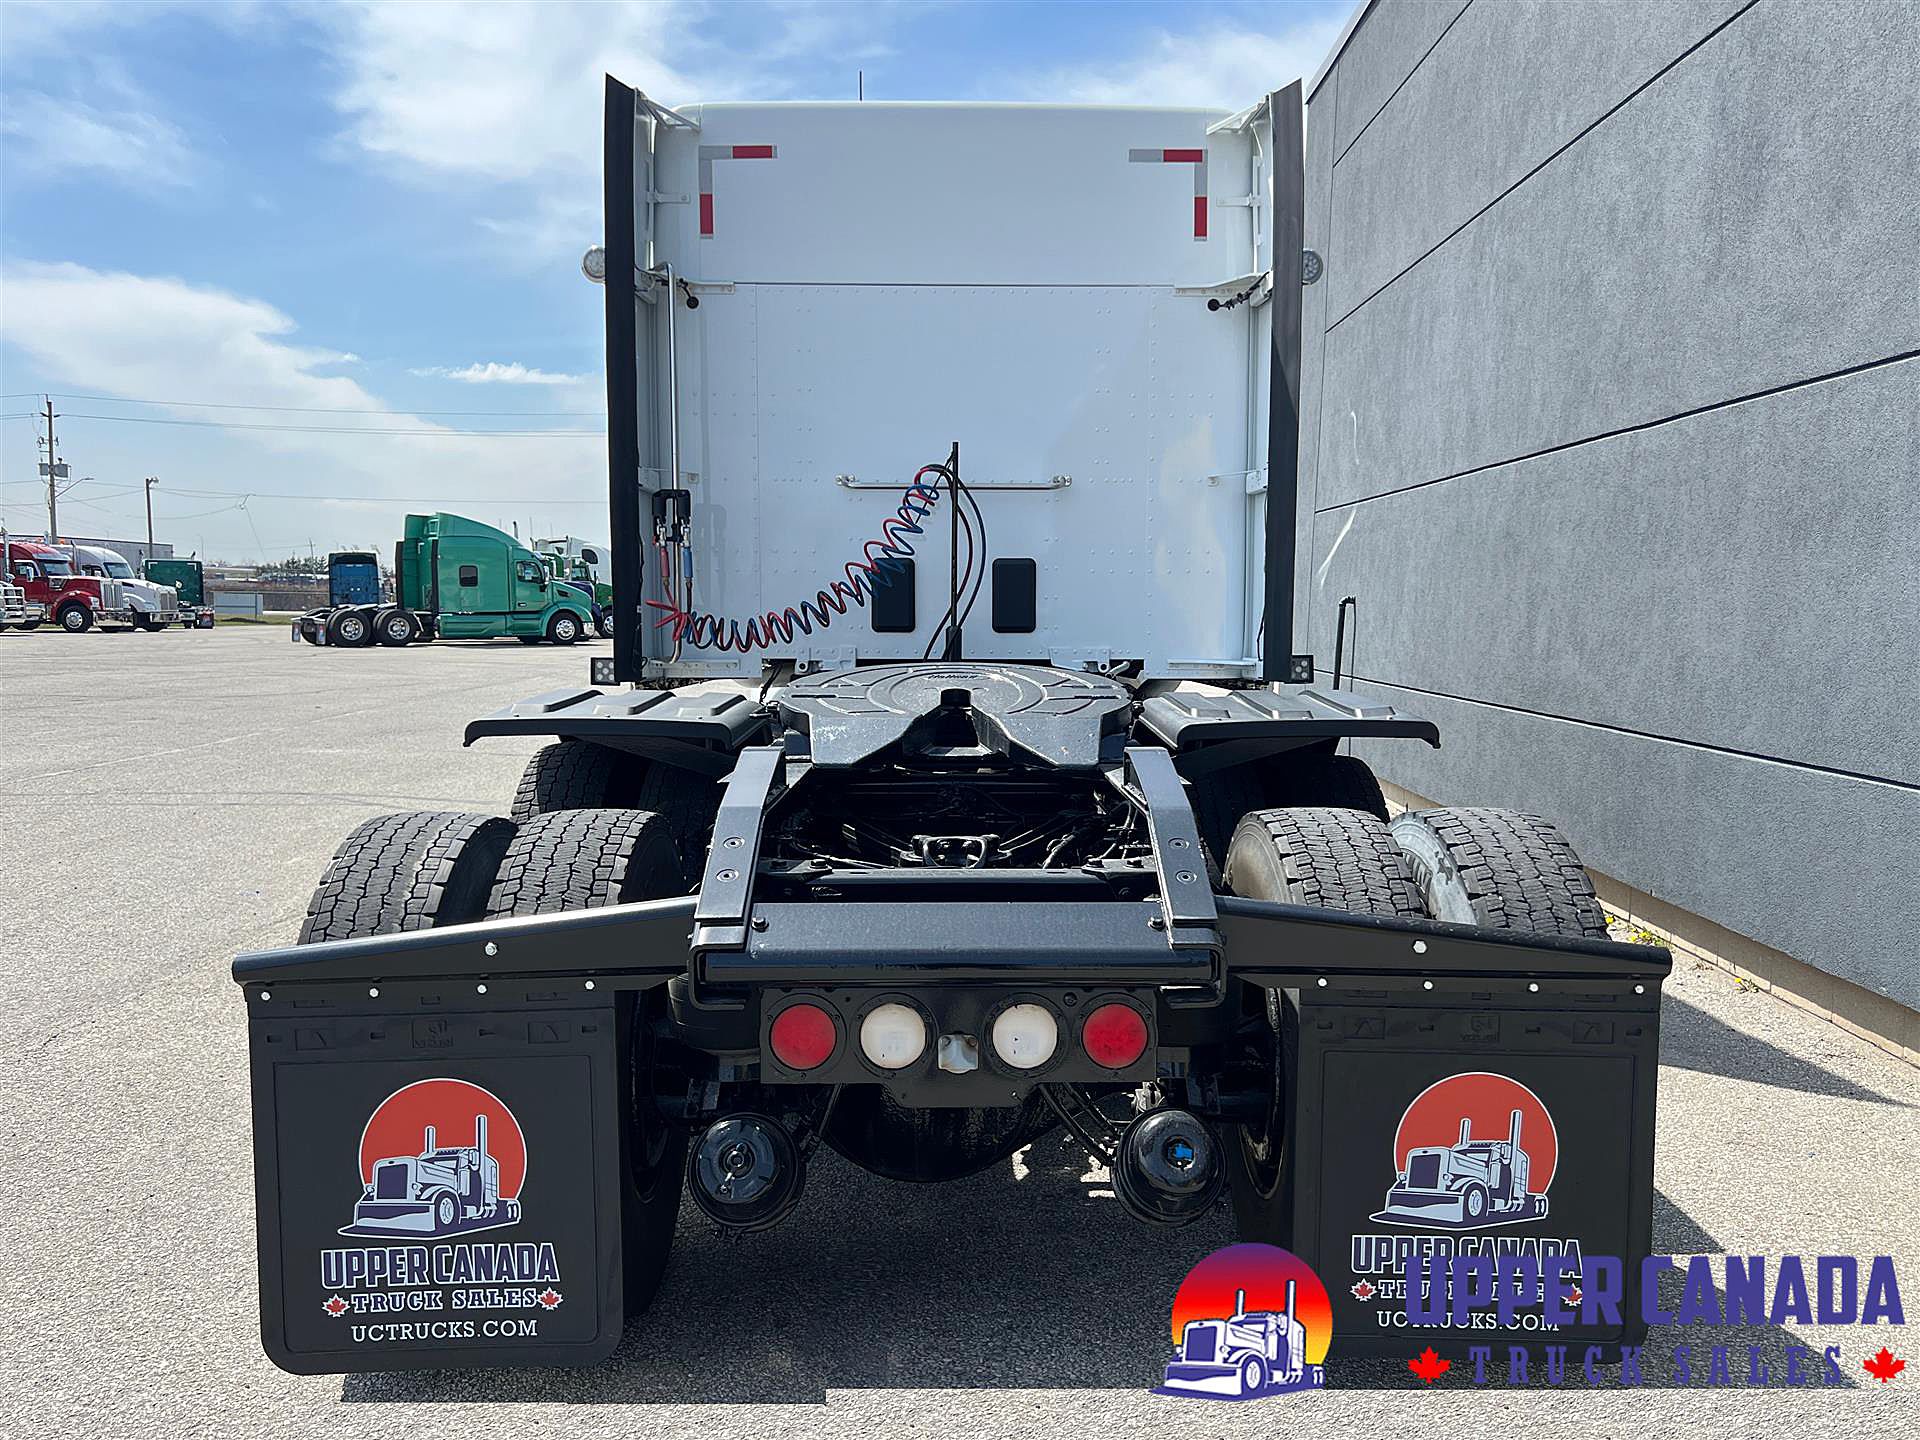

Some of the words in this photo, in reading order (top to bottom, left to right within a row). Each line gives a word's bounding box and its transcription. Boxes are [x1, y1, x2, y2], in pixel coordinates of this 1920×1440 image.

[321, 1245, 430, 1289] UPPER
[433, 1242, 561, 1284] CANADA
[1351, 1234, 1455, 1275] UPPER
[351, 1291, 443, 1314] TRUCK
[452, 1288, 538, 1310] SALES
[351, 1319, 538, 1342] UCTRUCKS.COM
